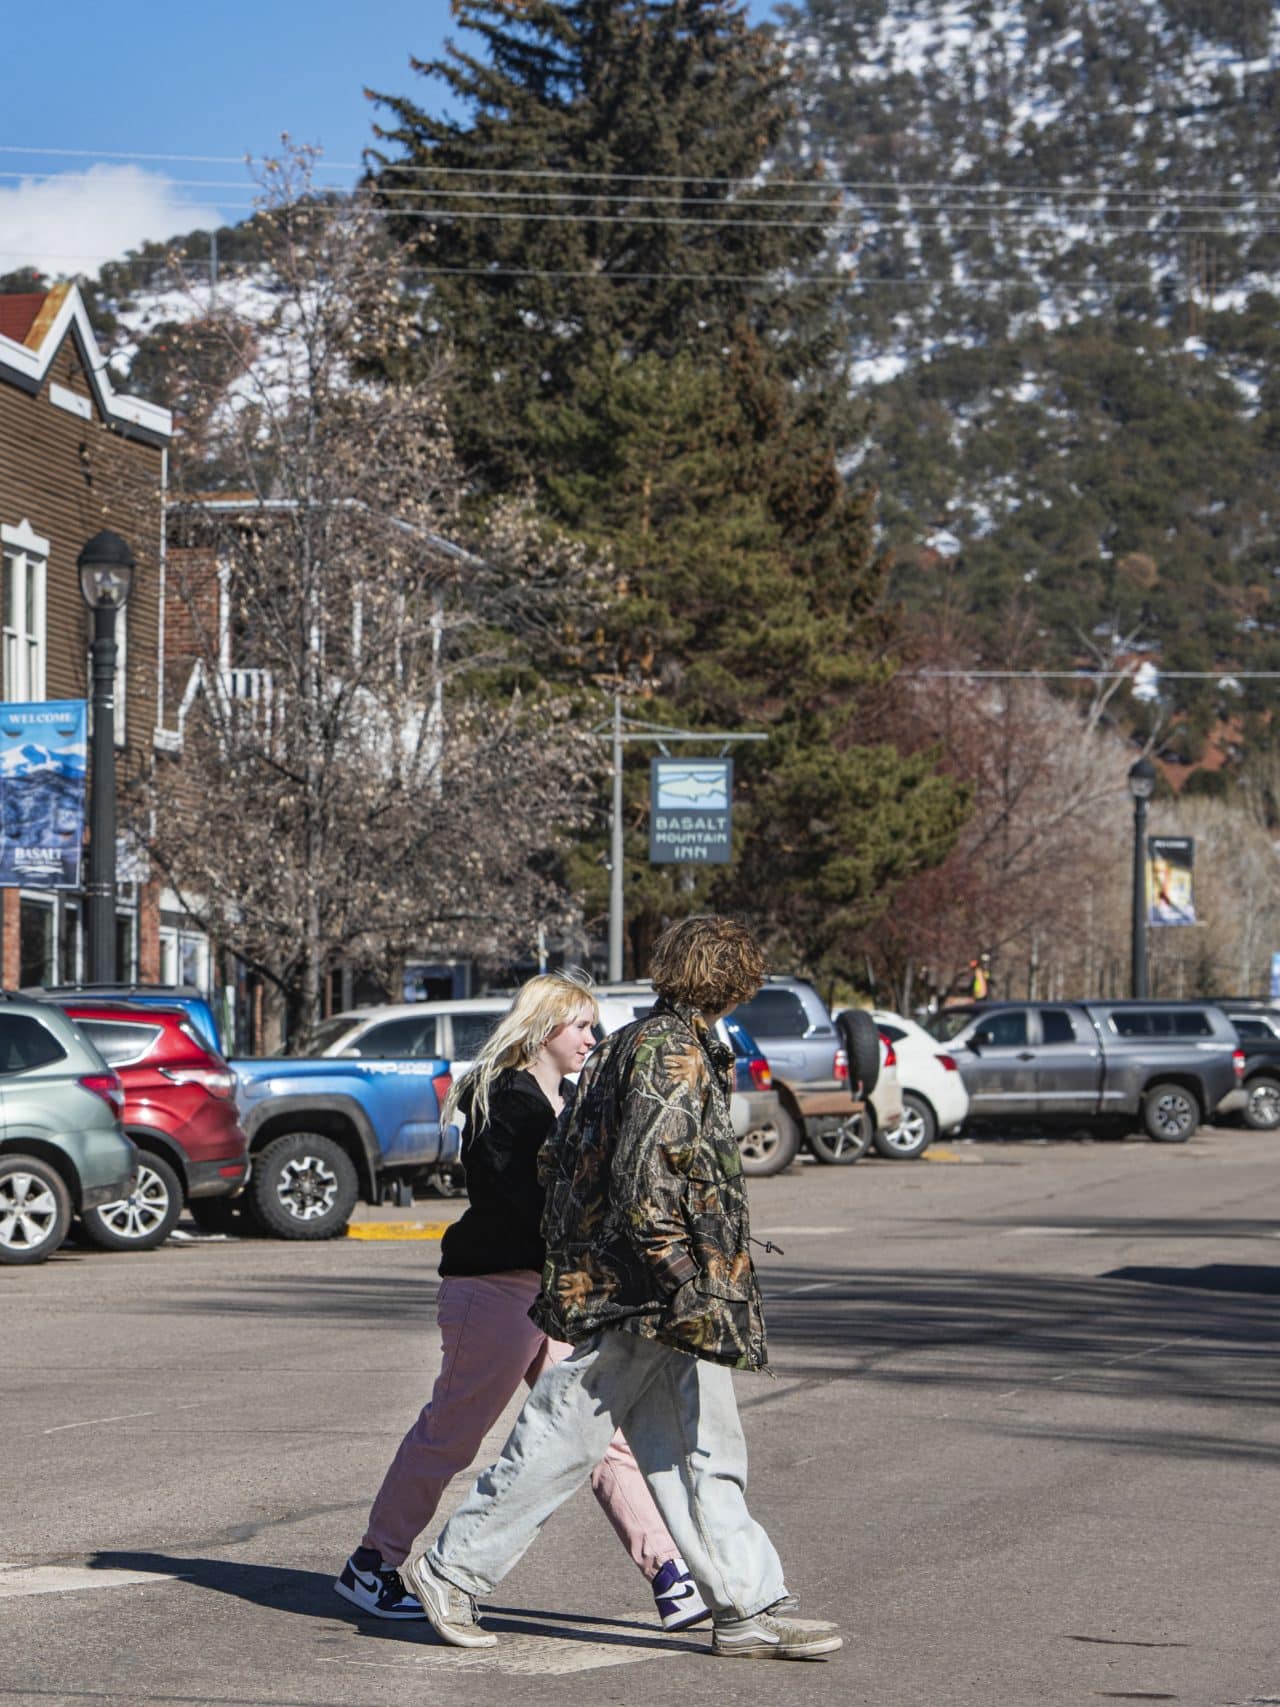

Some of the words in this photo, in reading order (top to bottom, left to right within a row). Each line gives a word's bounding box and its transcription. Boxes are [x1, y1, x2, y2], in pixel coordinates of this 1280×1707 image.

[9, 712, 73, 723] WELCOME
[655, 816, 726, 831] BASALT
[655, 832, 727, 844] MOUNTAIN
[14, 847, 62, 860] BASALT
[674, 846, 708, 859] INN
